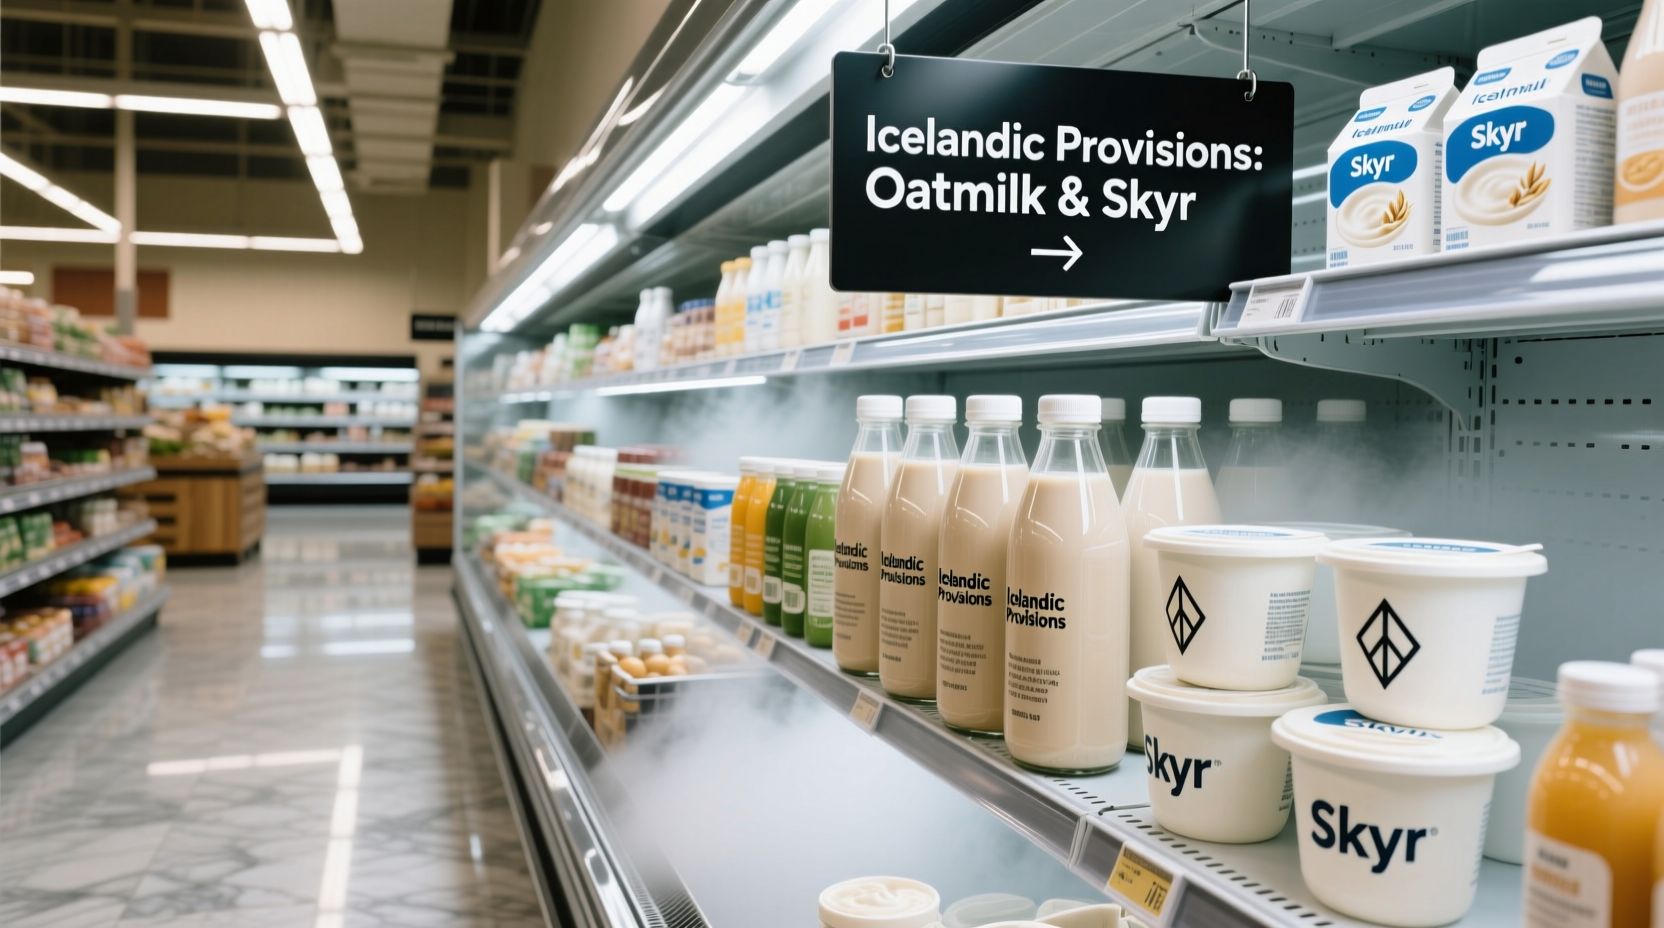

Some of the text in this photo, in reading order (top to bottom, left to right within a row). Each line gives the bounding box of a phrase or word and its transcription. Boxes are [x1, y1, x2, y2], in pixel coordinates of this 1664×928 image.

[866, 115, 1263, 170] Icelandic Provisions:
[1471, 120, 1527, 152] Skyr
[1350, 153, 1395, 180] Skyr
[866, 167, 1197, 231] Oatmilk & Skyr
[1145, 734, 1212, 797] Skyr
[1311, 800, 1427, 875] Skyr
